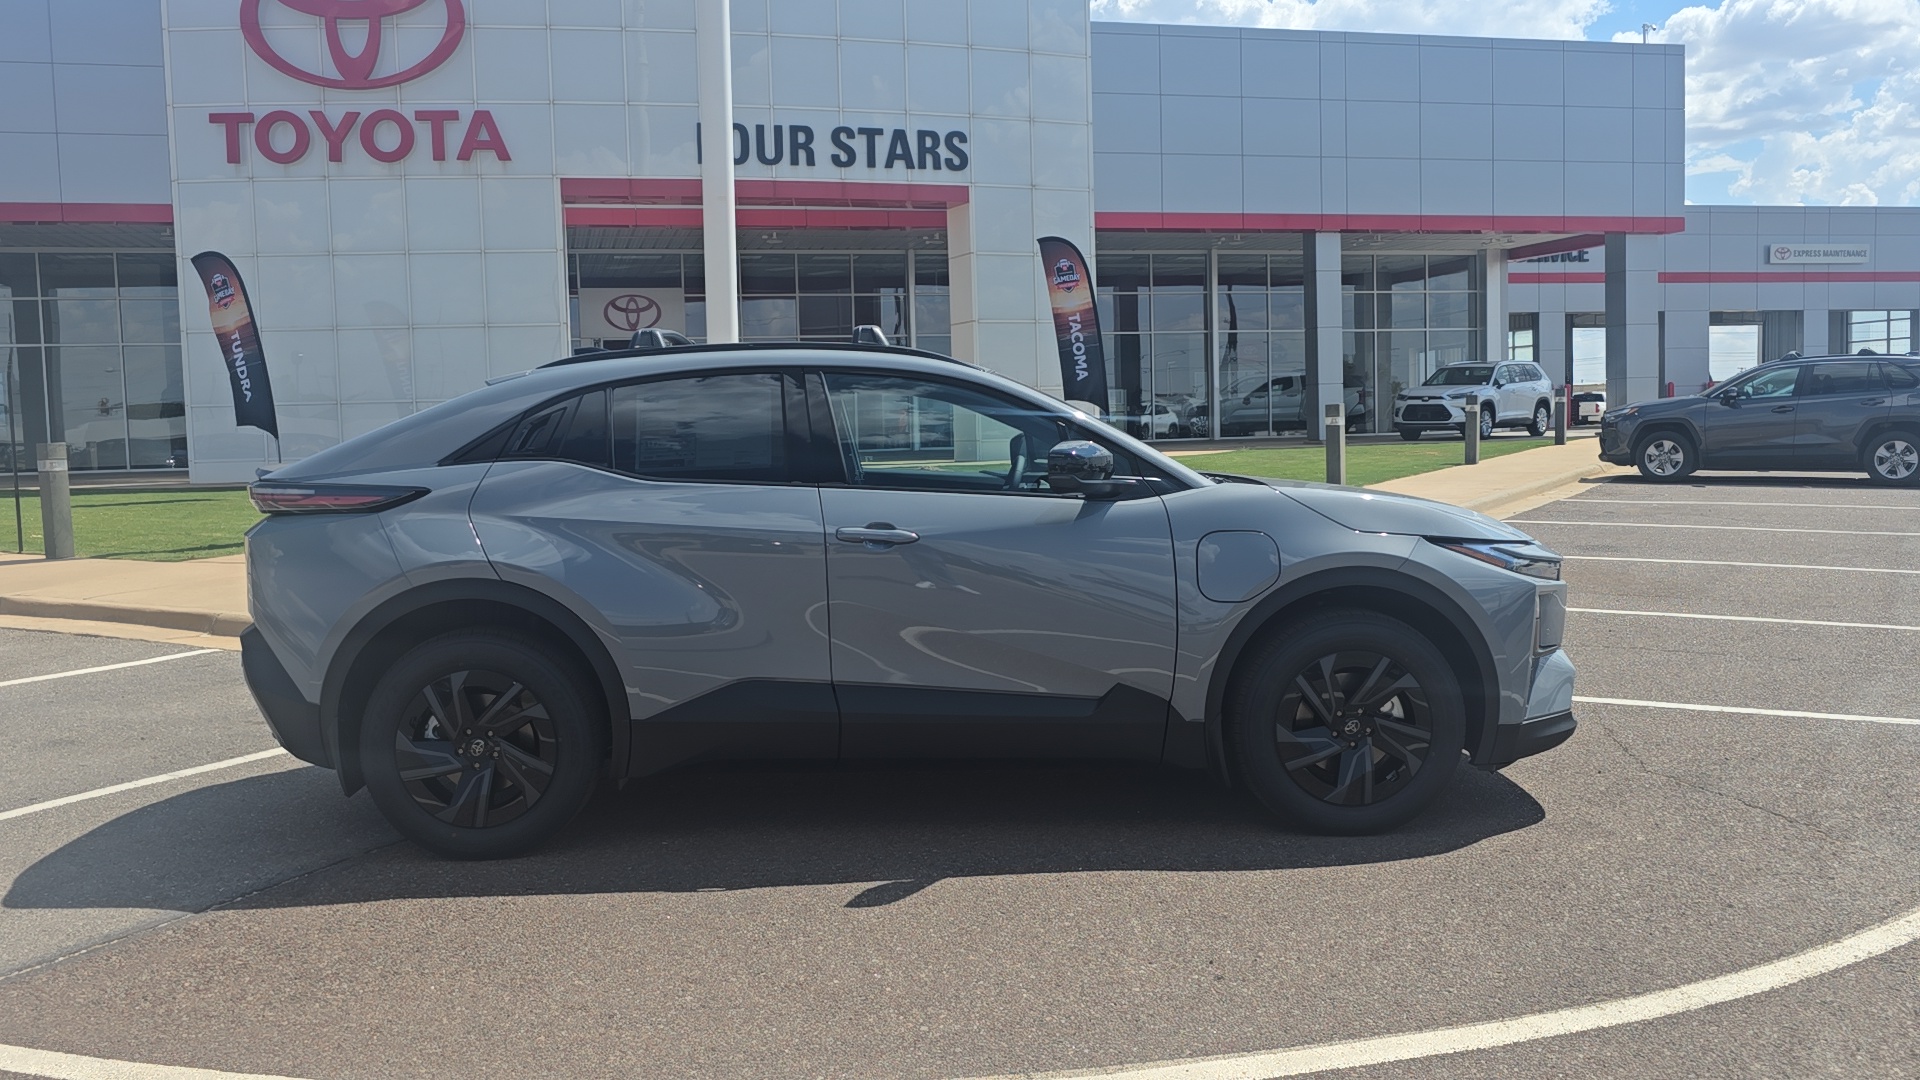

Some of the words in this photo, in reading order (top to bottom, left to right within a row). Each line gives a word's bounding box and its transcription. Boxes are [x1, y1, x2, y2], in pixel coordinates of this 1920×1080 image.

[208, 108, 512, 165] TOYOTA
[696, 122, 816, 167] OUR
[830, 126, 969, 171] STARS
[1793, 249, 1821, 258] EXPRESS
[1822, 249, 1868, 258] MAINTENANCE
[230, 330, 252, 403] TUNDRA
[1068, 312, 1089, 382] TACOMA
